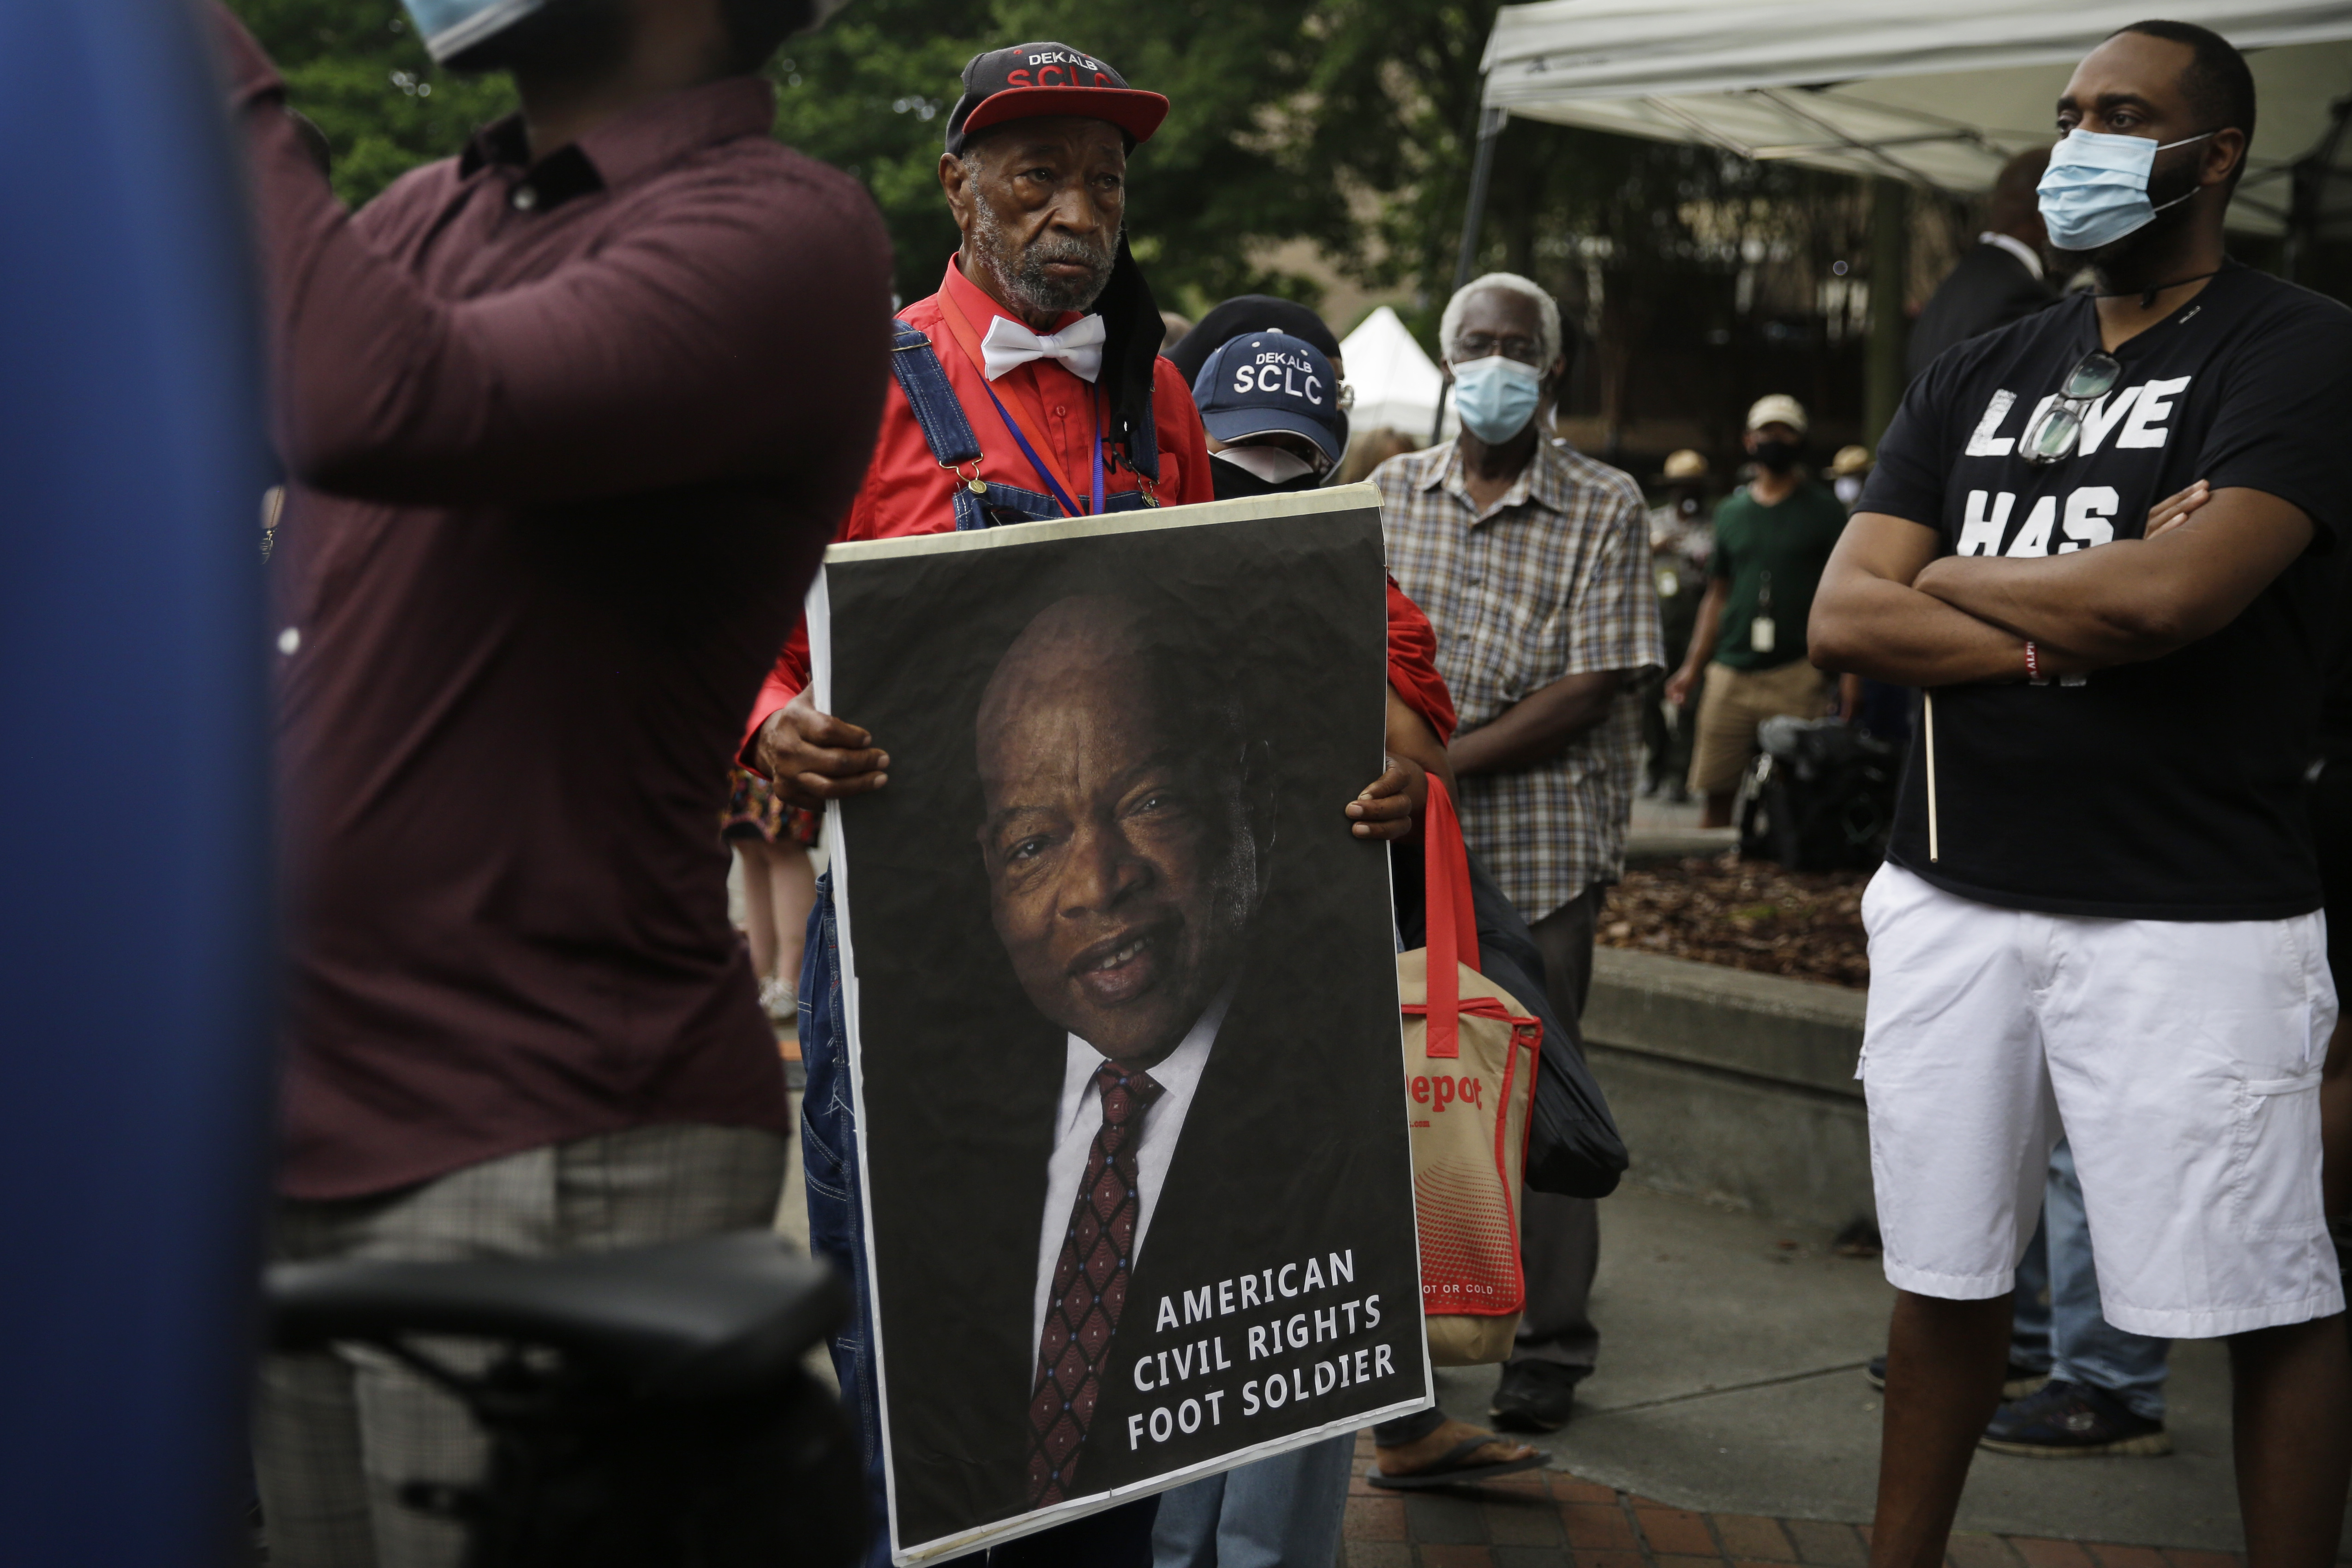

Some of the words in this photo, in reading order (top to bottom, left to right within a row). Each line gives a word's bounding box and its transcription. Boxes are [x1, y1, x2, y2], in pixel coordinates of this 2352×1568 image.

[1029, 52, 1098, 71] DEKALB
[1233, 365, 1323, 405] SCLC
[1256, 352, 1313, 373] DEKALB
[1964, 376, 2192, 457] LOVE
[1957, 486, 2119, 558] HAS
[1406, 1074, 1483, 1112] epot
[1156, 1249, 1354, 1333] AMERICAN
[1442, 1284, 1460, 1293] OR
[1466, 1284, 1493, 1294] COLD
[1134, 1336, 1231, 1391] CIVIL
[1248, 1294, 1381, 1361] RIGHTS
[1128, 1390, 1224, 1450] FOOT
[1242, 1344, 1395, 1416] SOLDIER
